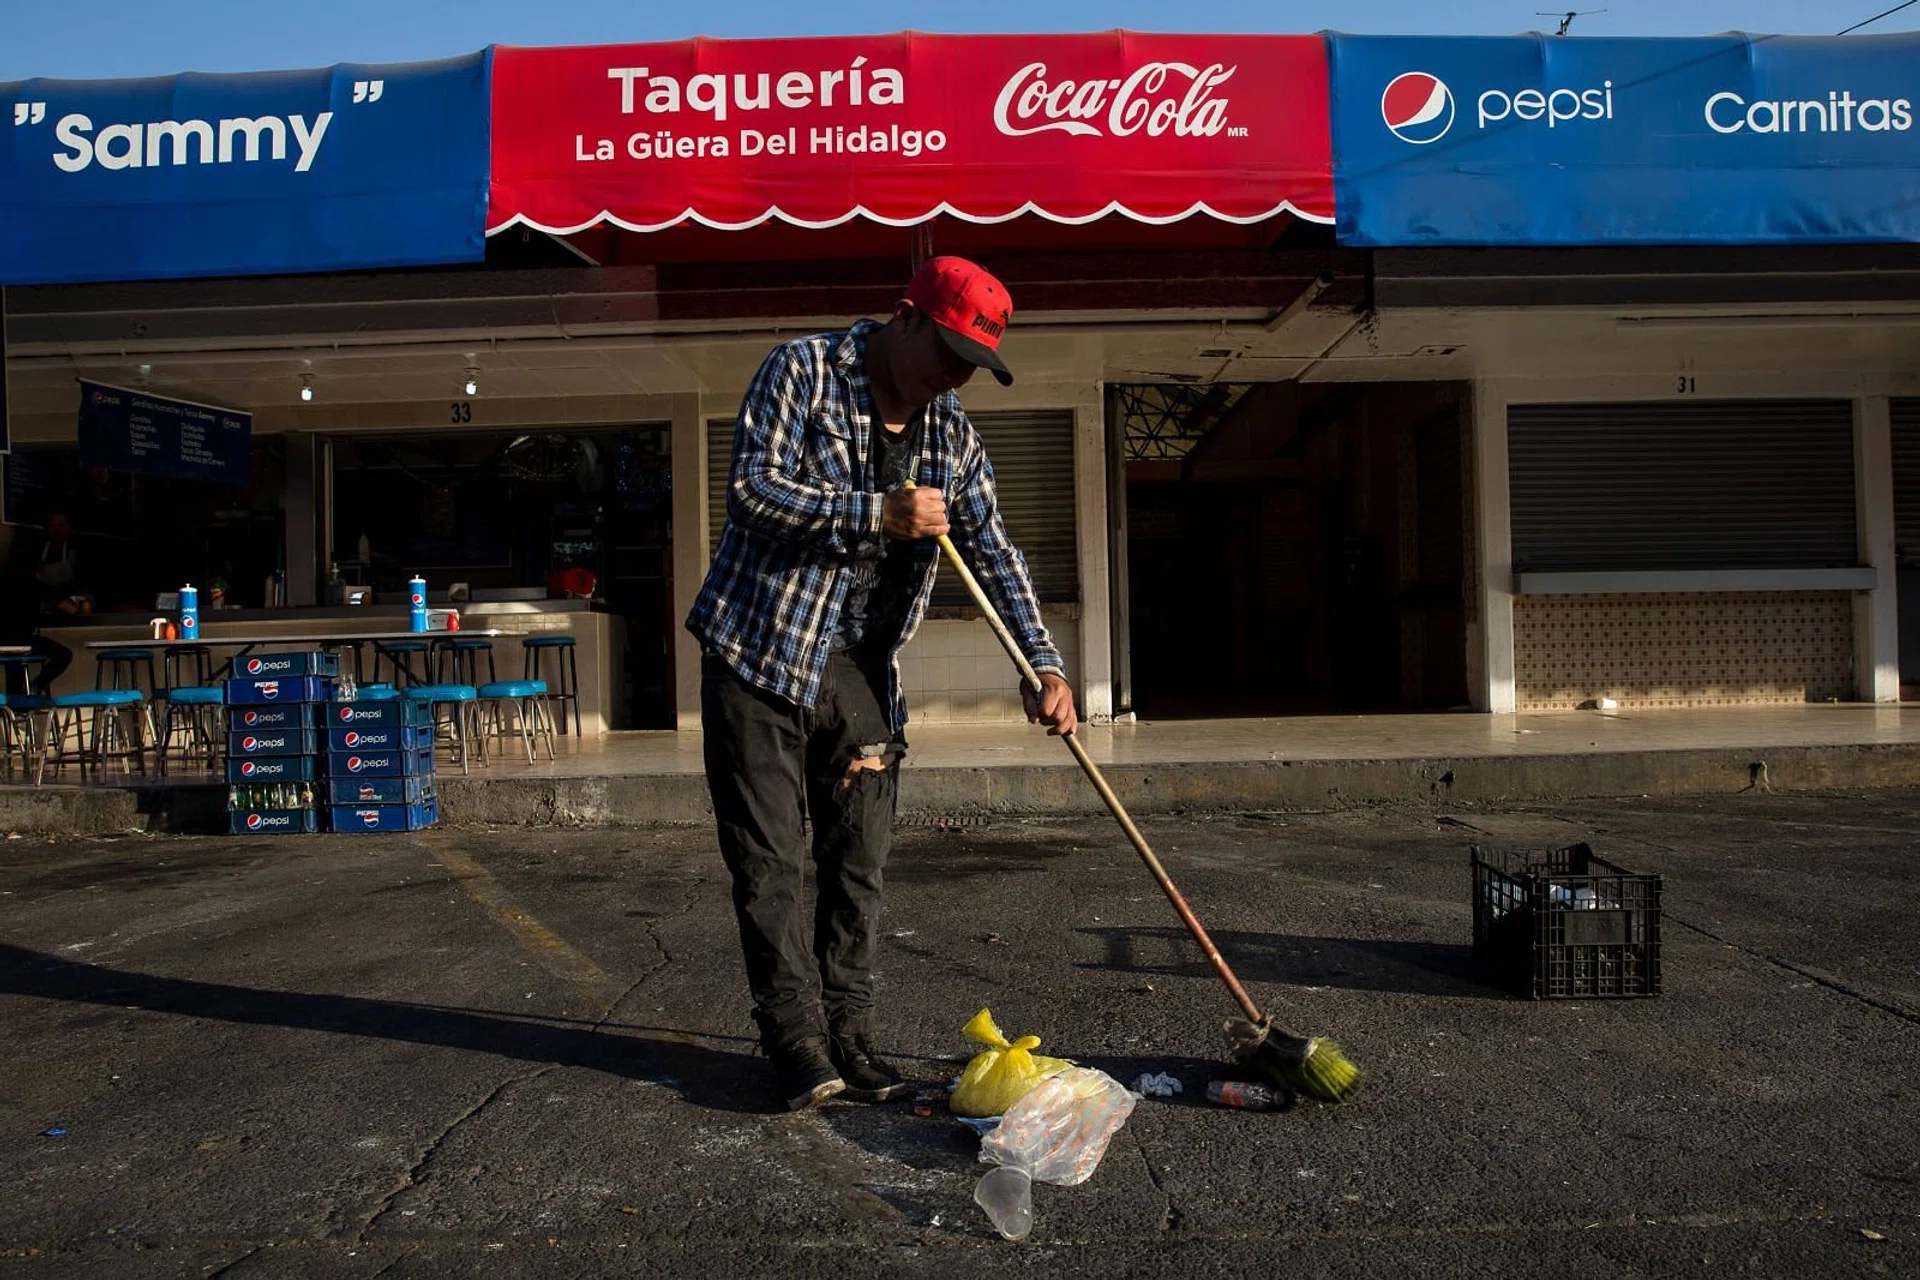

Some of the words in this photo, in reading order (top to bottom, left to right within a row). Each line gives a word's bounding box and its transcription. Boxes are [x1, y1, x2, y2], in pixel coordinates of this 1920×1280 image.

[608, 56, 904, 120] Taquería
[993, 62, 1238, 138] Coca-Cola
[1227, 127, 1249, 137] MR
[1478, 80, 1613, 129] pepsi
[1704, 90, 1912, 134] Carnitas
[52, 112, 334, 172] Sammy
[576, 134, 615, 161] La
[627, 130, 729, 160] Güera
[740, 127, 796, 156] Del
[810, 124, 947, 157] Hidalgo
[972, 312, 1004, 339] PUM
[1677, 376, 1695, 393] 31
[451, 402, 472, 423] 33
[263, 660, 290, 673] pepsi
[258, 712, 285, 723] pepsi
[355, 709, 382, 720] pepsi
[258, 737, 285, 749] pepsi
[360, 734, 387, 746] pepsi
[256, 763, 284, 775] pepsi
[363, 758, 389, 769] pepsi
[263, 815, 290, 827] pepsi
